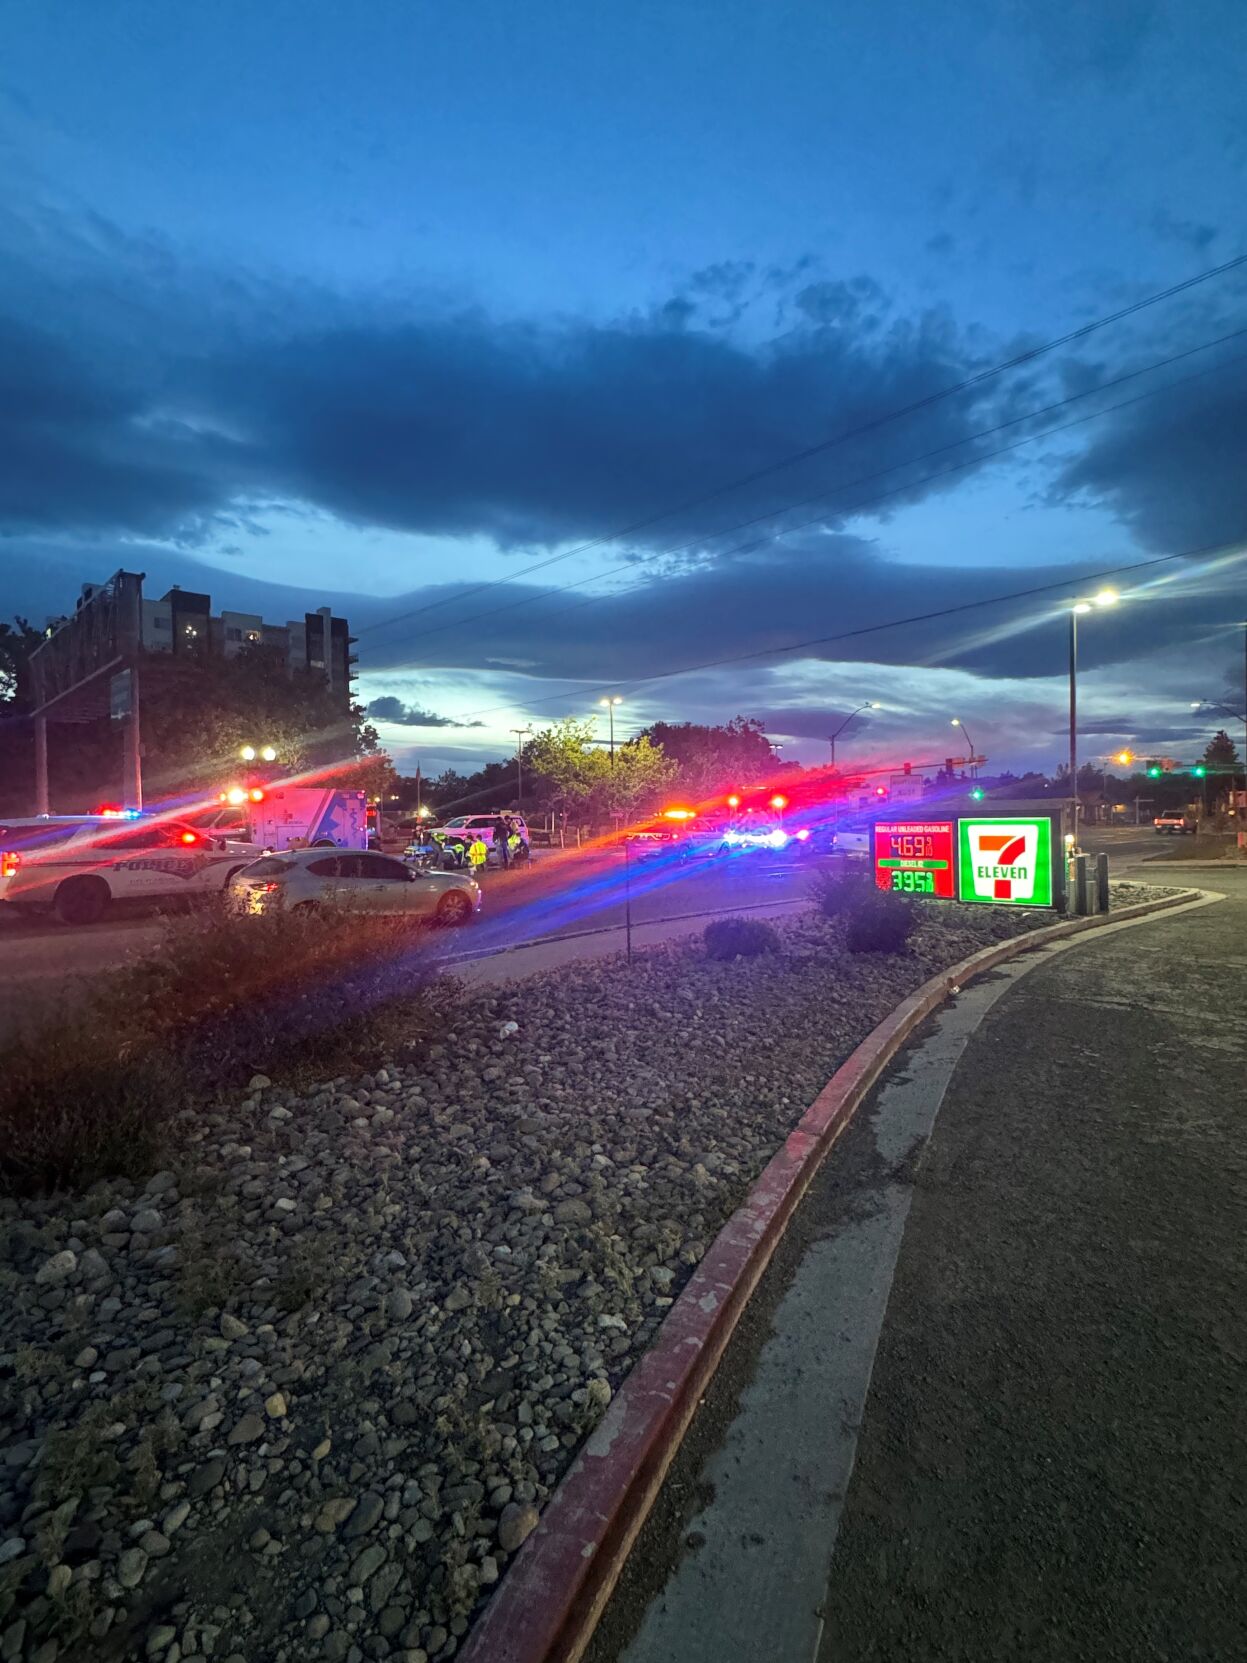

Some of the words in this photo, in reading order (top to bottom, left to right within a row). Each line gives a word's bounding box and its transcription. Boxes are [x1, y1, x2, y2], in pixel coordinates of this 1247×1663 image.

[924, 825, 950, 833] GASOLINE
[113, 859, 189, 872] POLICE
[978, 835, 1026, 899] 7
